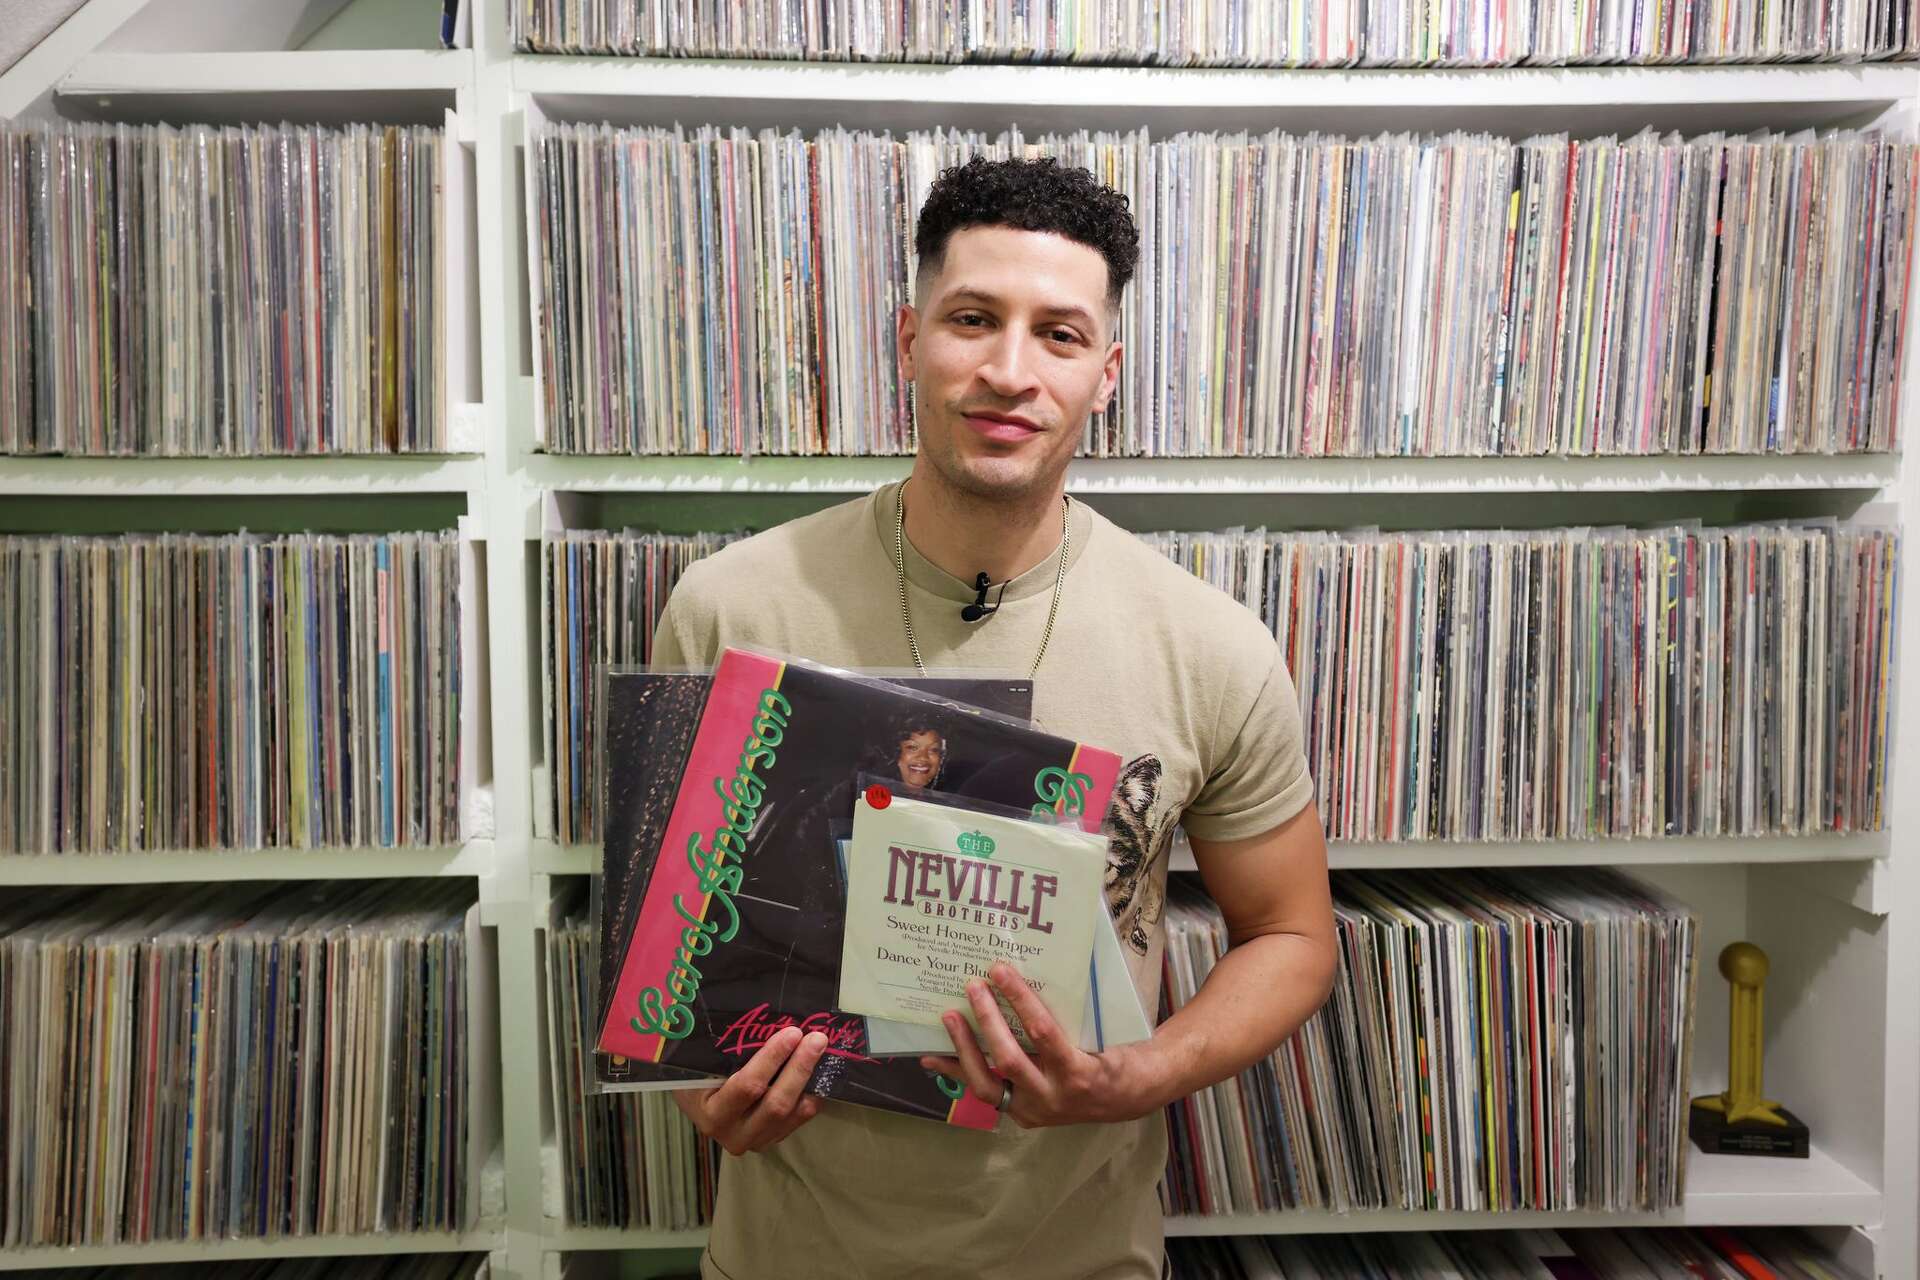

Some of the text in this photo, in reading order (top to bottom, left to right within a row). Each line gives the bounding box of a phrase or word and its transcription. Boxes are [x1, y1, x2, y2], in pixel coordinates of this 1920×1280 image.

[962, 838, 991, 852] THE
[631, 688, 792, 1040] Carol Anderson
[883, 846, 1058, 934] NEVILLE
[924, 903, 1019, 931] BROTHERS
[887, 914, 1044, 956] Sweet Honey Dripper
[877, 946, 921, 967] Dance
[926, 955, 960, 973] Your
